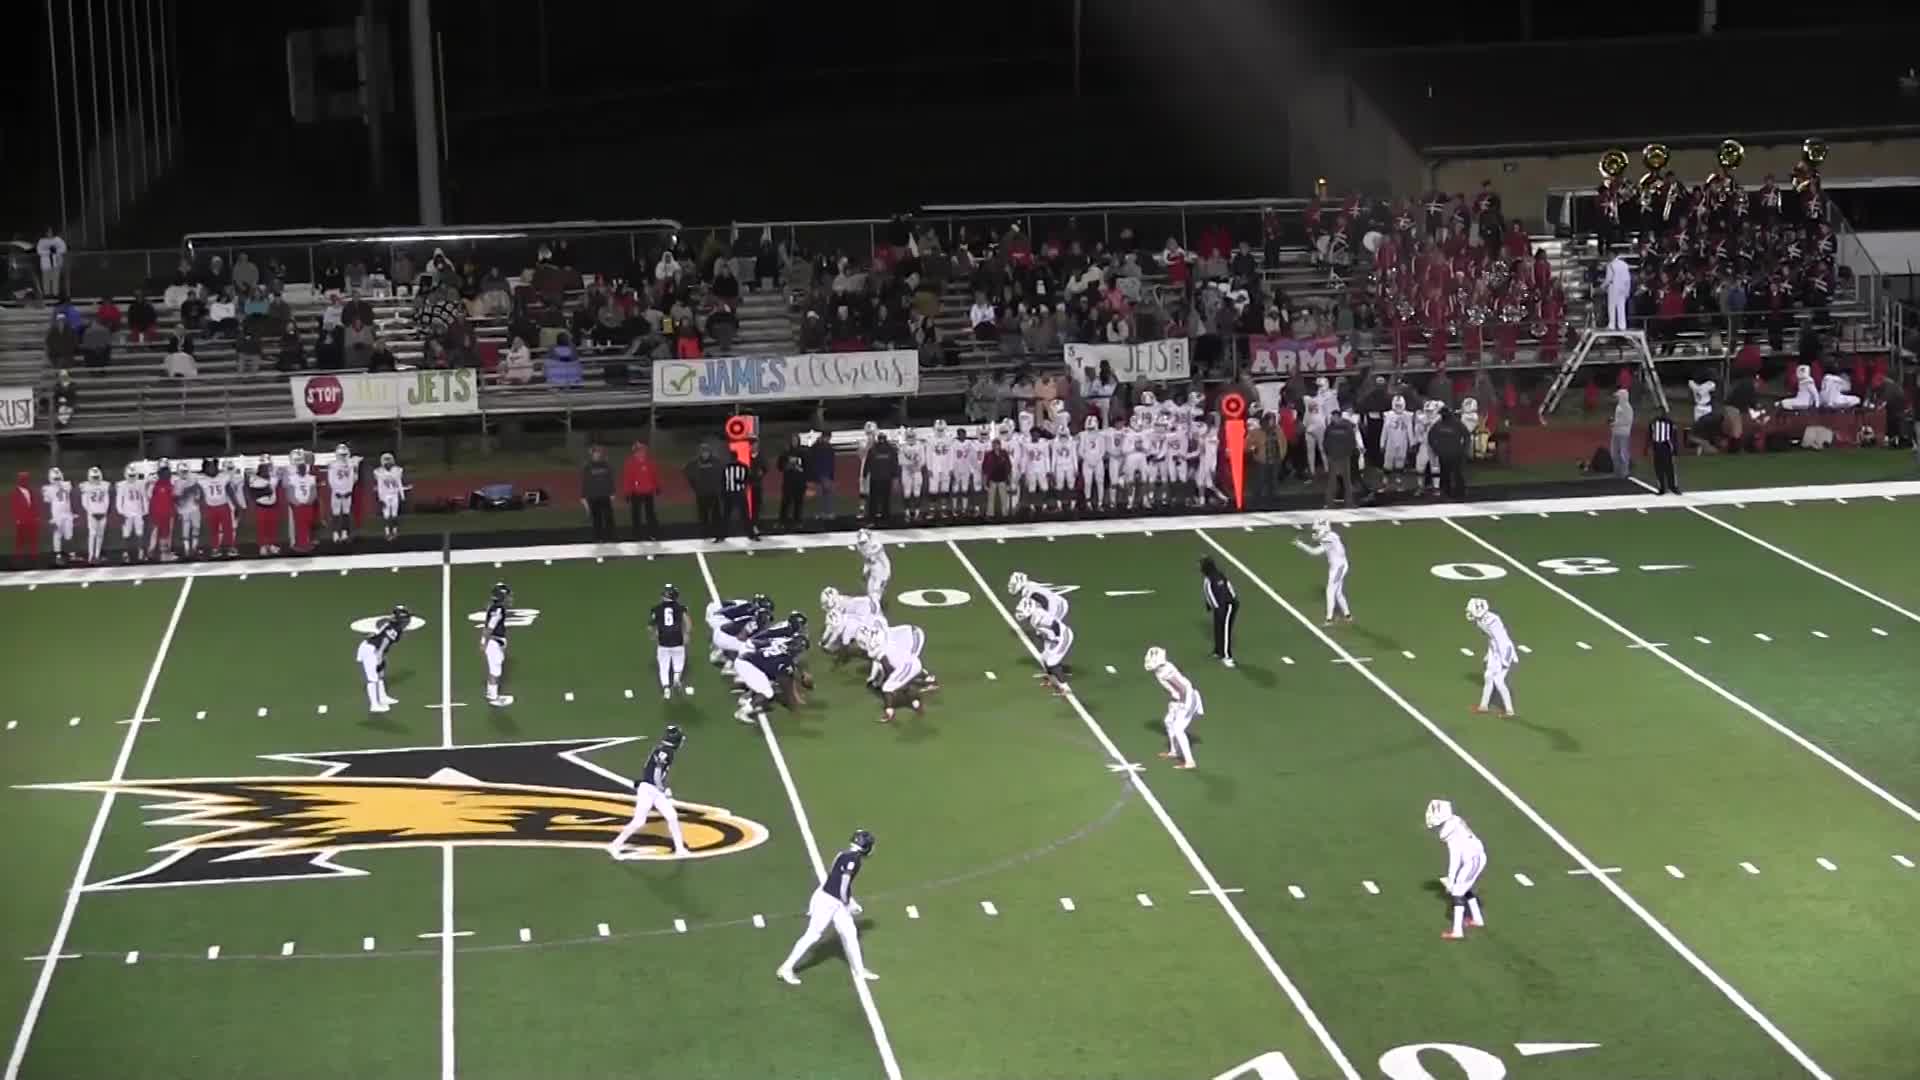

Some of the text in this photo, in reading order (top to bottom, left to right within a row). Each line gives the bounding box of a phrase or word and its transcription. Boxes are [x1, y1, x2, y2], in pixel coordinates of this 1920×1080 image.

[1251, 340, 1352, 373] ARMY
[408, 368, 471, 405] JETS
[700, 358, 787, 395] JAMES
[664, 607, 674, 626] 6
